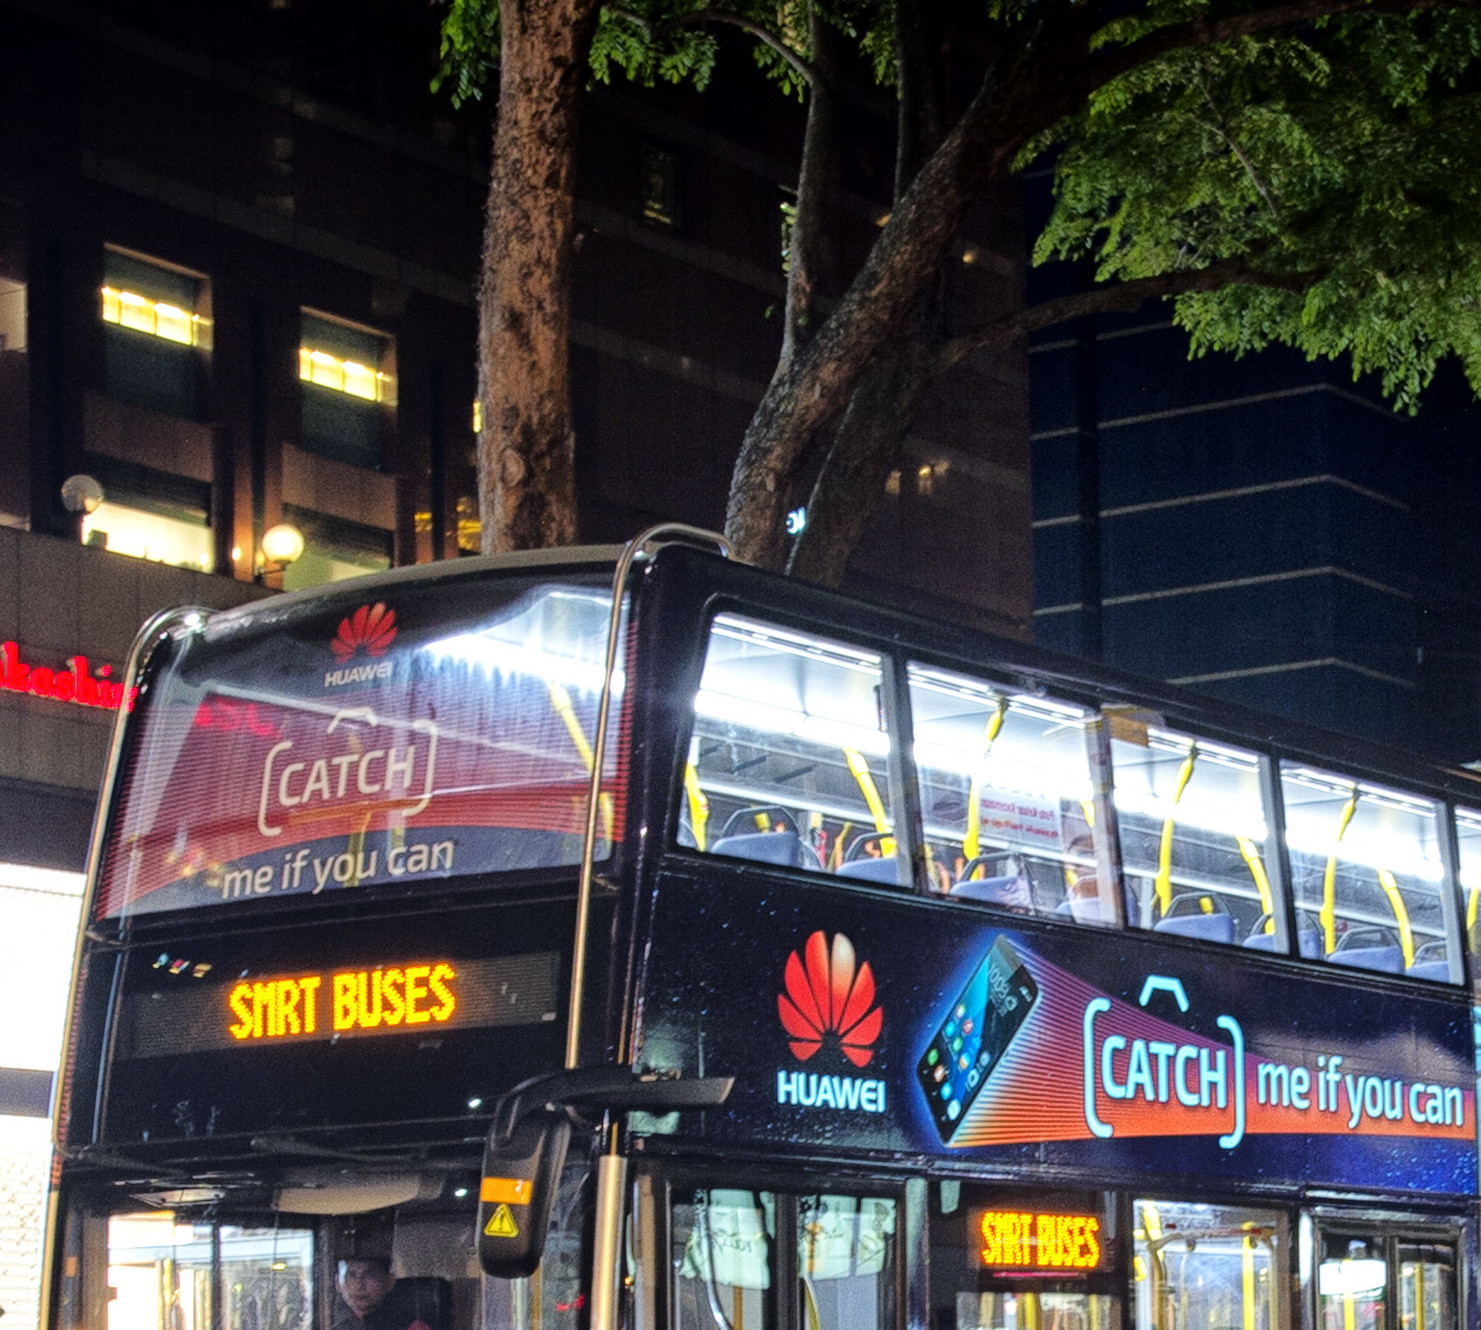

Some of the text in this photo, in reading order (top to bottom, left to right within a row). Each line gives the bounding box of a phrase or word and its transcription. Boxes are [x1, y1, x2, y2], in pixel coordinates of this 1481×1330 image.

[324, 661, 394, 688] HUAWEI
[278, 746, 416, 807] CATCH
[222, 840, 455, 900] me if you can
[228, 962, 456, 1040] SMRT BUSES
[777, 1069, 886, 1113] HUAWEI
[1102, 1034, 1464, 1130] CATCH me if you can
